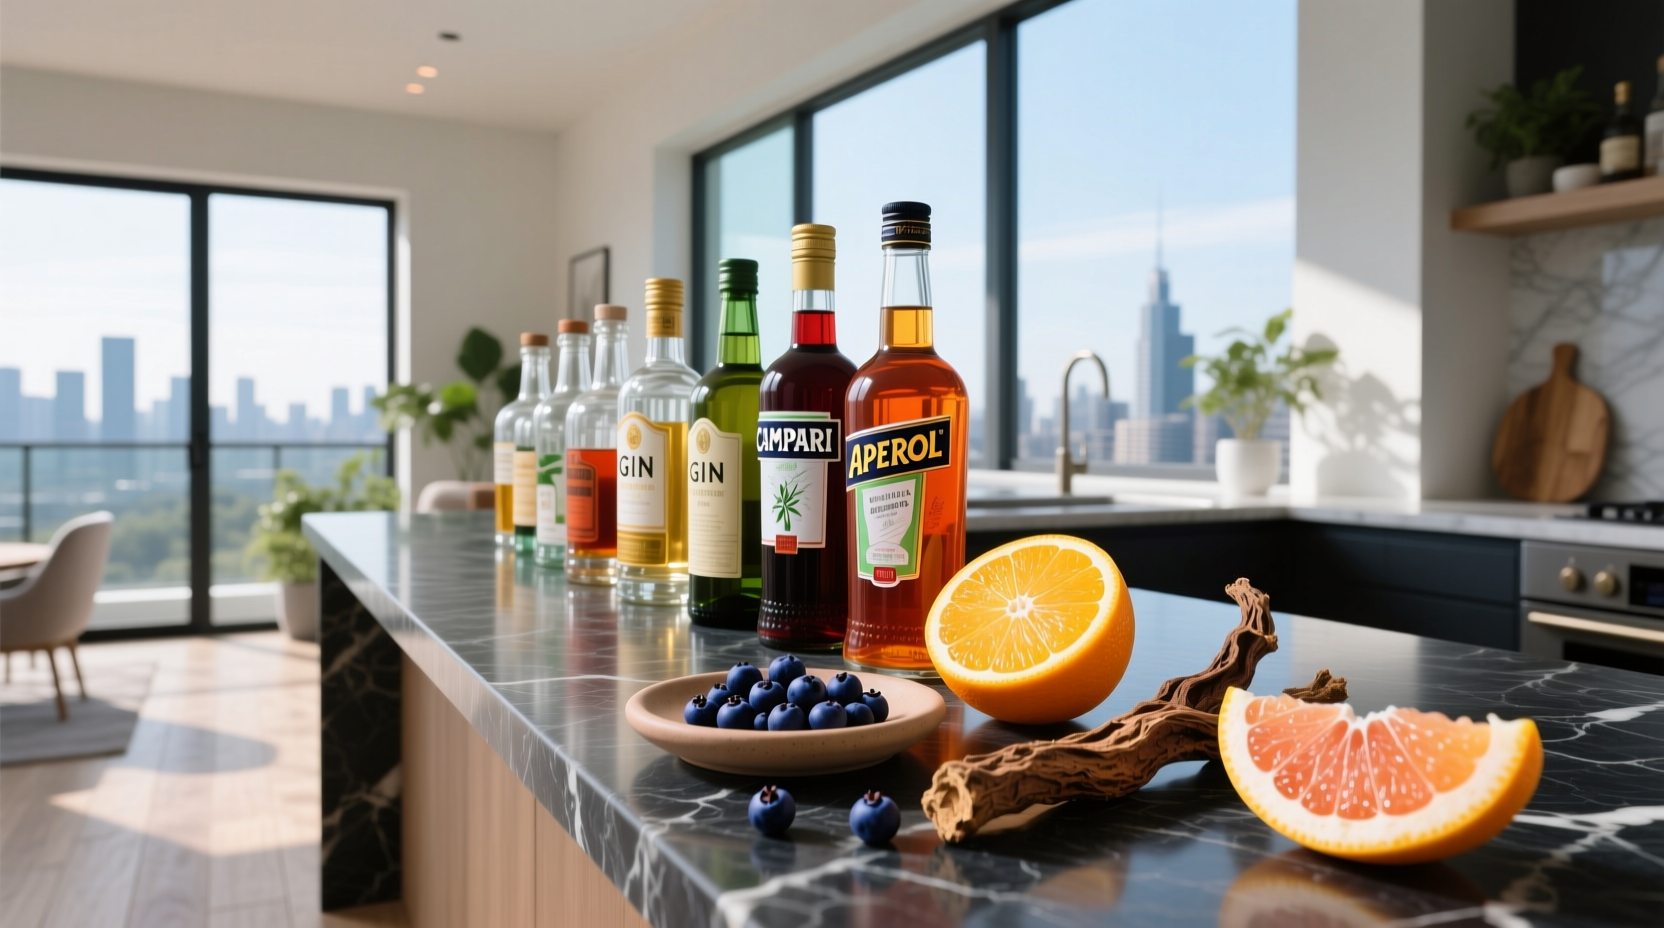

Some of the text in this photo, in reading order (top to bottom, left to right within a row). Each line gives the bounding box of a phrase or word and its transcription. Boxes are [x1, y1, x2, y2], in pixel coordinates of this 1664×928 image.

[757, 427, 832, 452] CAMPARI
[848, 430, 942, 478] APEROL
[619, 455, 653, 478] GIN
[690, 461, 723, 483] GIN
